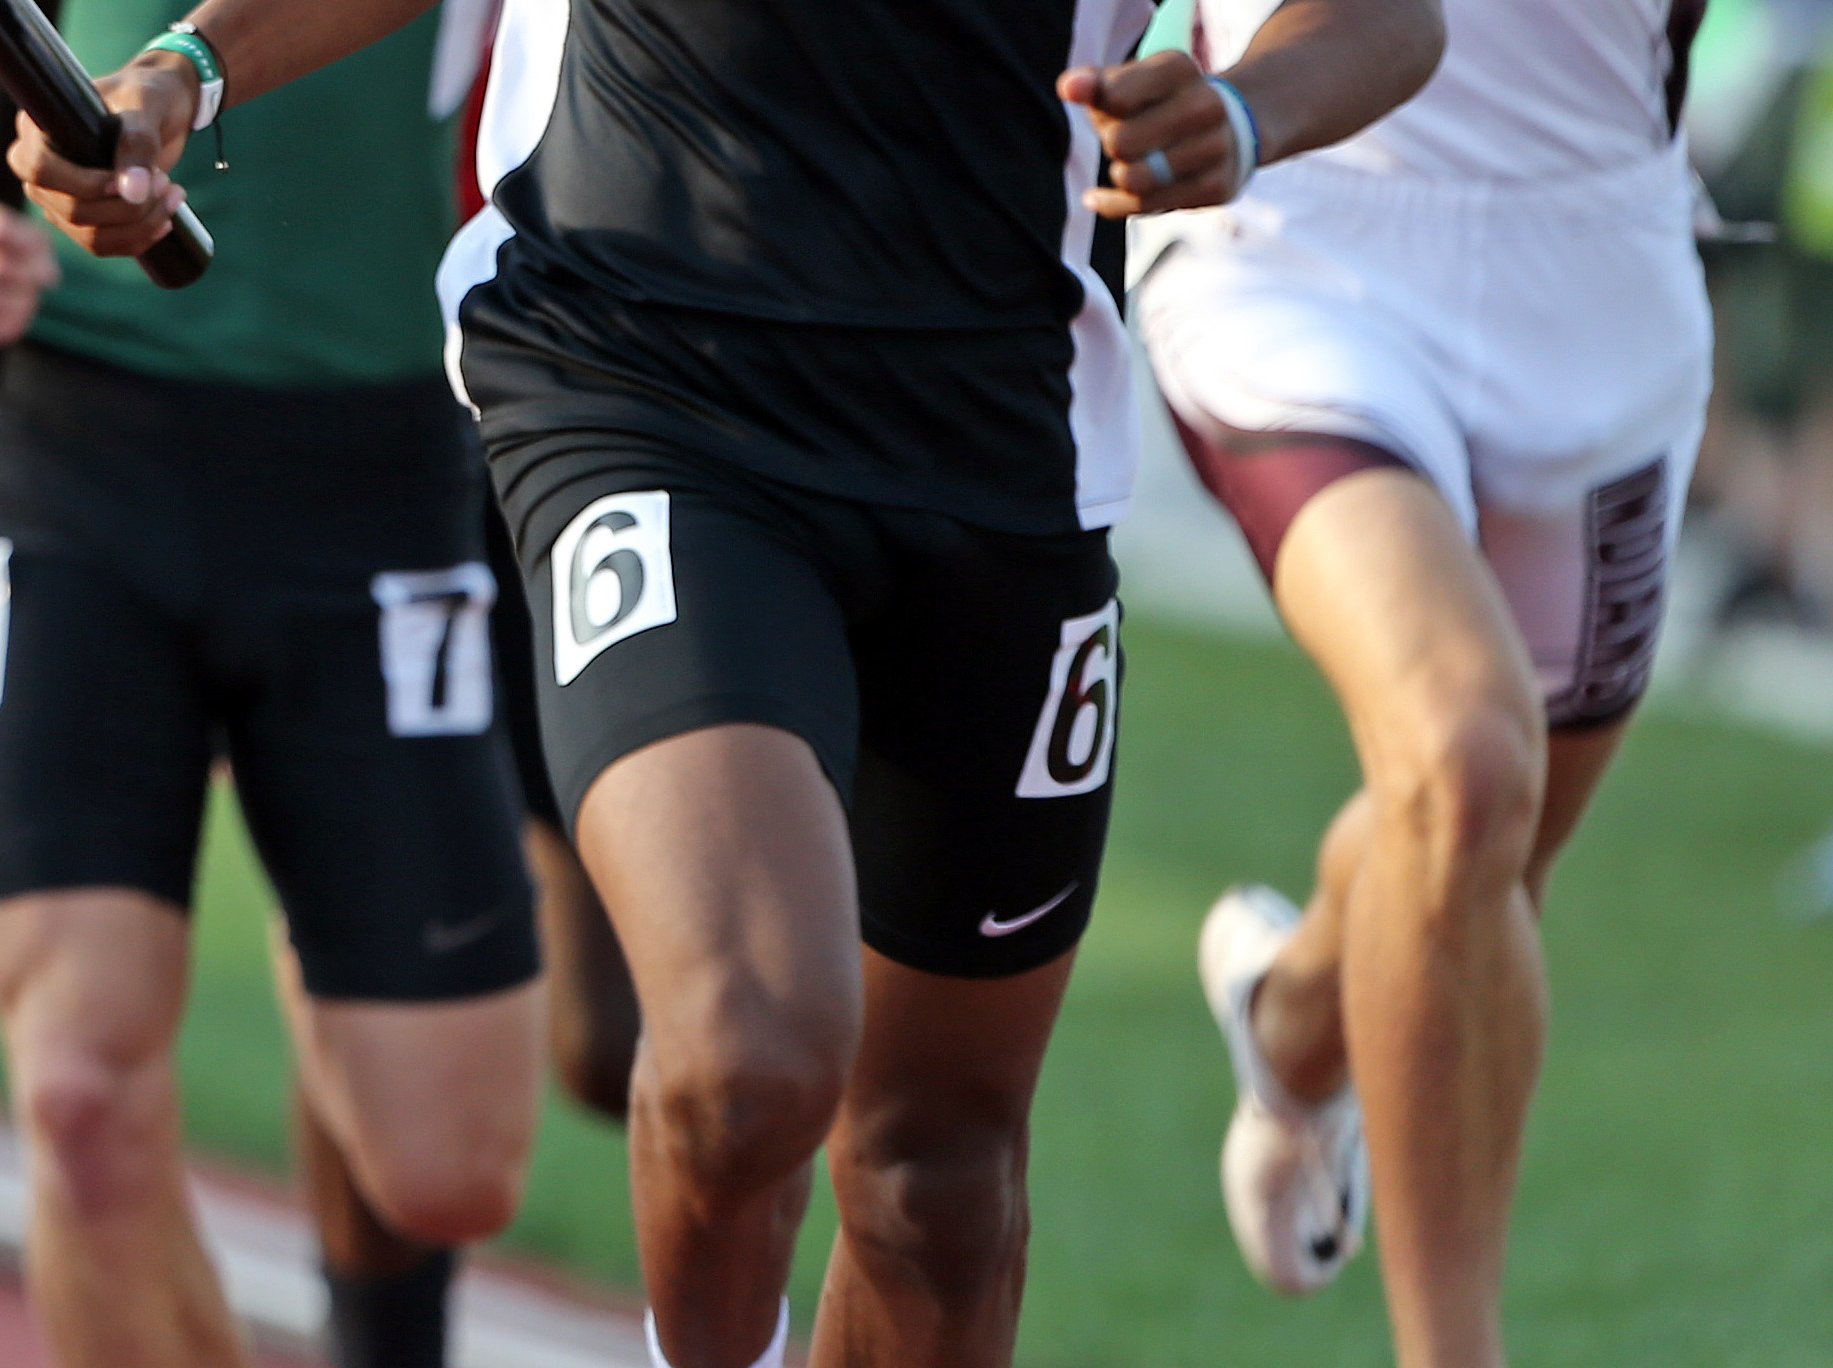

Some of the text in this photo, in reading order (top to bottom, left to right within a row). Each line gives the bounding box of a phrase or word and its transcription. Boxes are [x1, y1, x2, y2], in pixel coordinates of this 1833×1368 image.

[570, 511, 644, 647] 6
[411, 590, 470, 707] 7
[1047, 623, 1111, 785] 6
